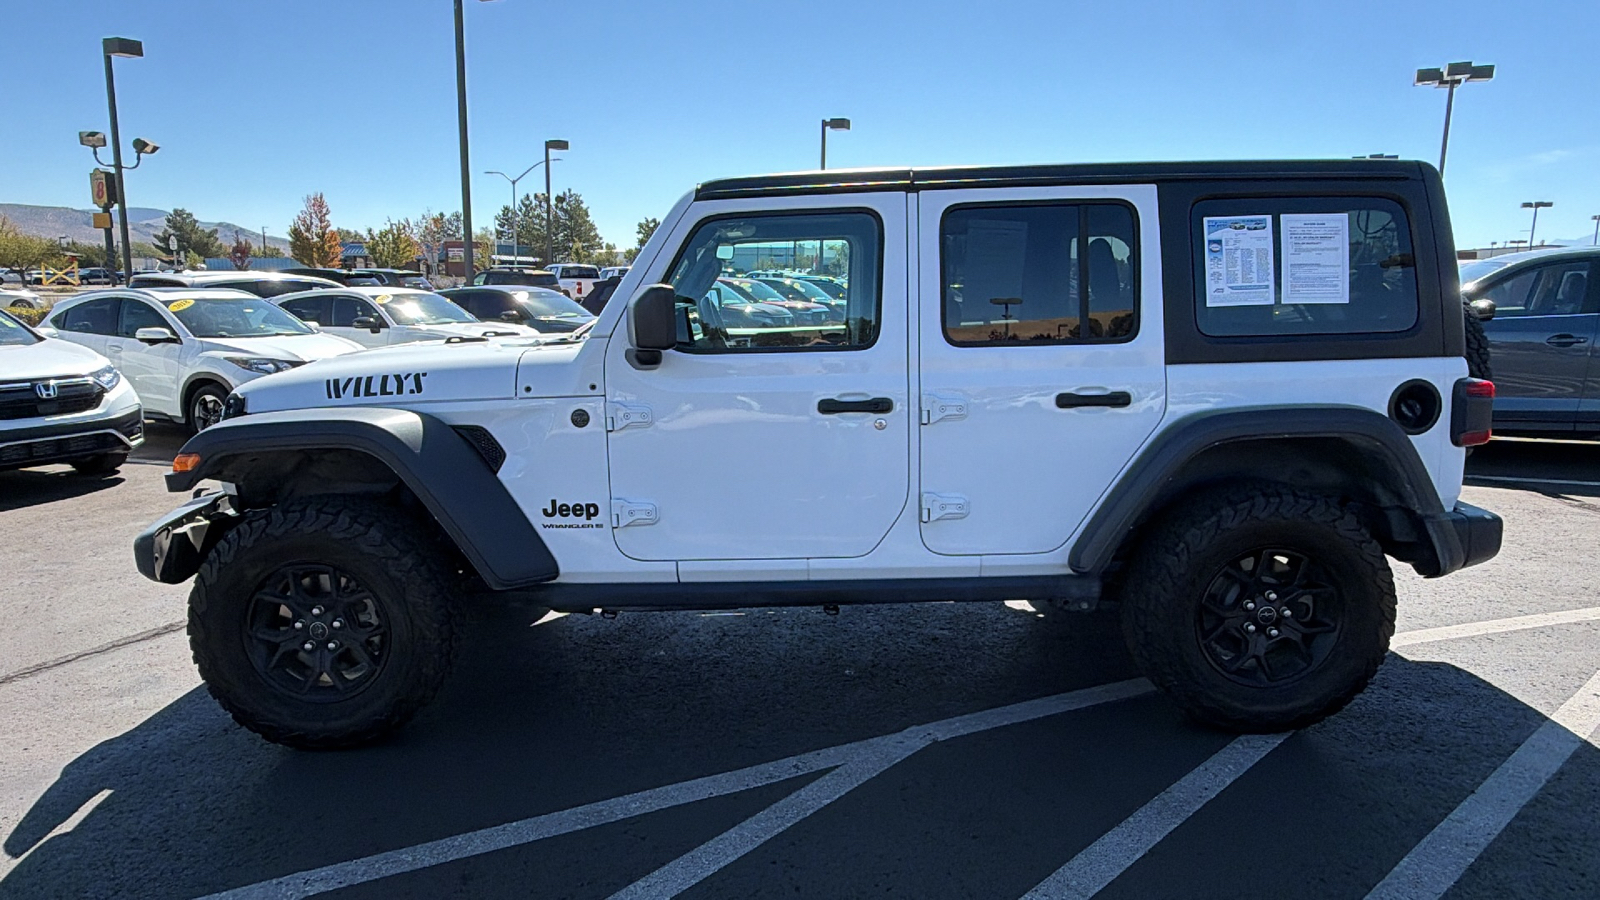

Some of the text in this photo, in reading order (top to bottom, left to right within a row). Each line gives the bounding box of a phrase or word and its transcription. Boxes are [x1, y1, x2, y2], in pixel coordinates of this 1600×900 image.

[96, 181, 104, 199] 8
[325, 372, 428, 399] WILLYS
[542, 499, 599, 521] Jeep
